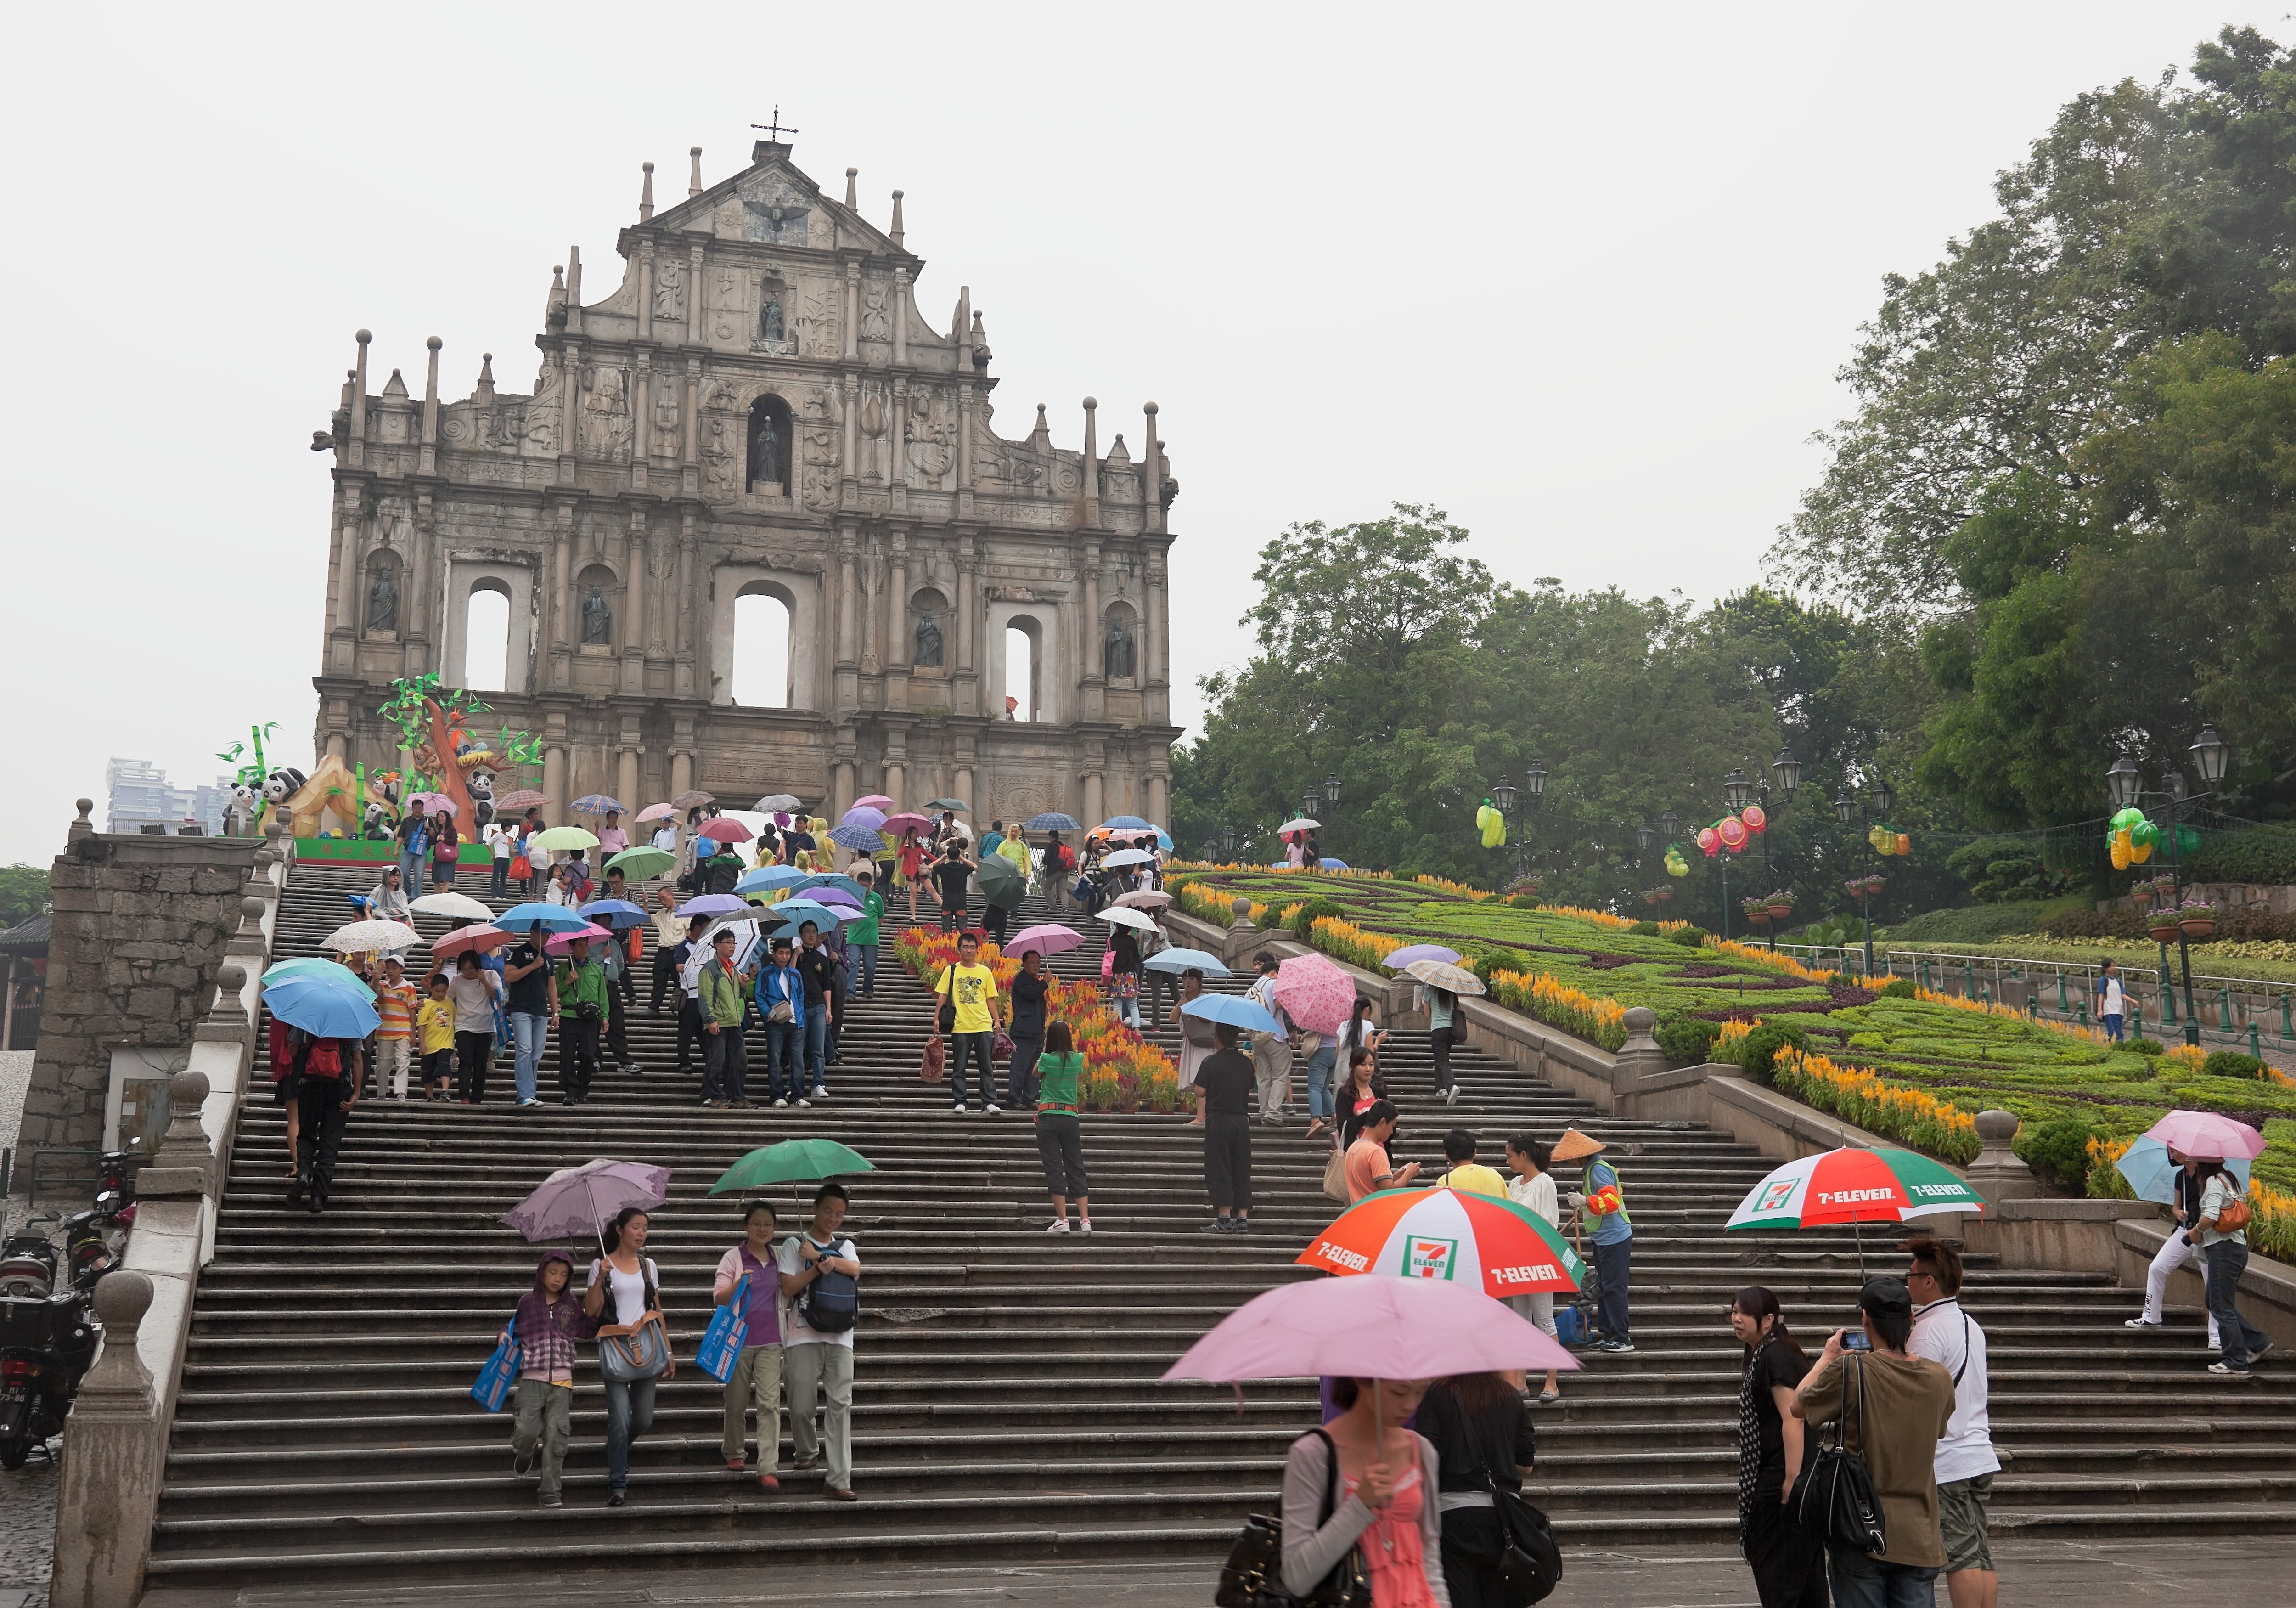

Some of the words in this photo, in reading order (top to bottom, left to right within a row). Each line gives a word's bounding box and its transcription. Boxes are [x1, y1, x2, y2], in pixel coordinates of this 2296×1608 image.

[707, 765, 772, 779] MATER
[779, 768, 812, 780] DEI
[506, 952, 513, 961] 3
[1, 1394, 25, 1402] 73-86
